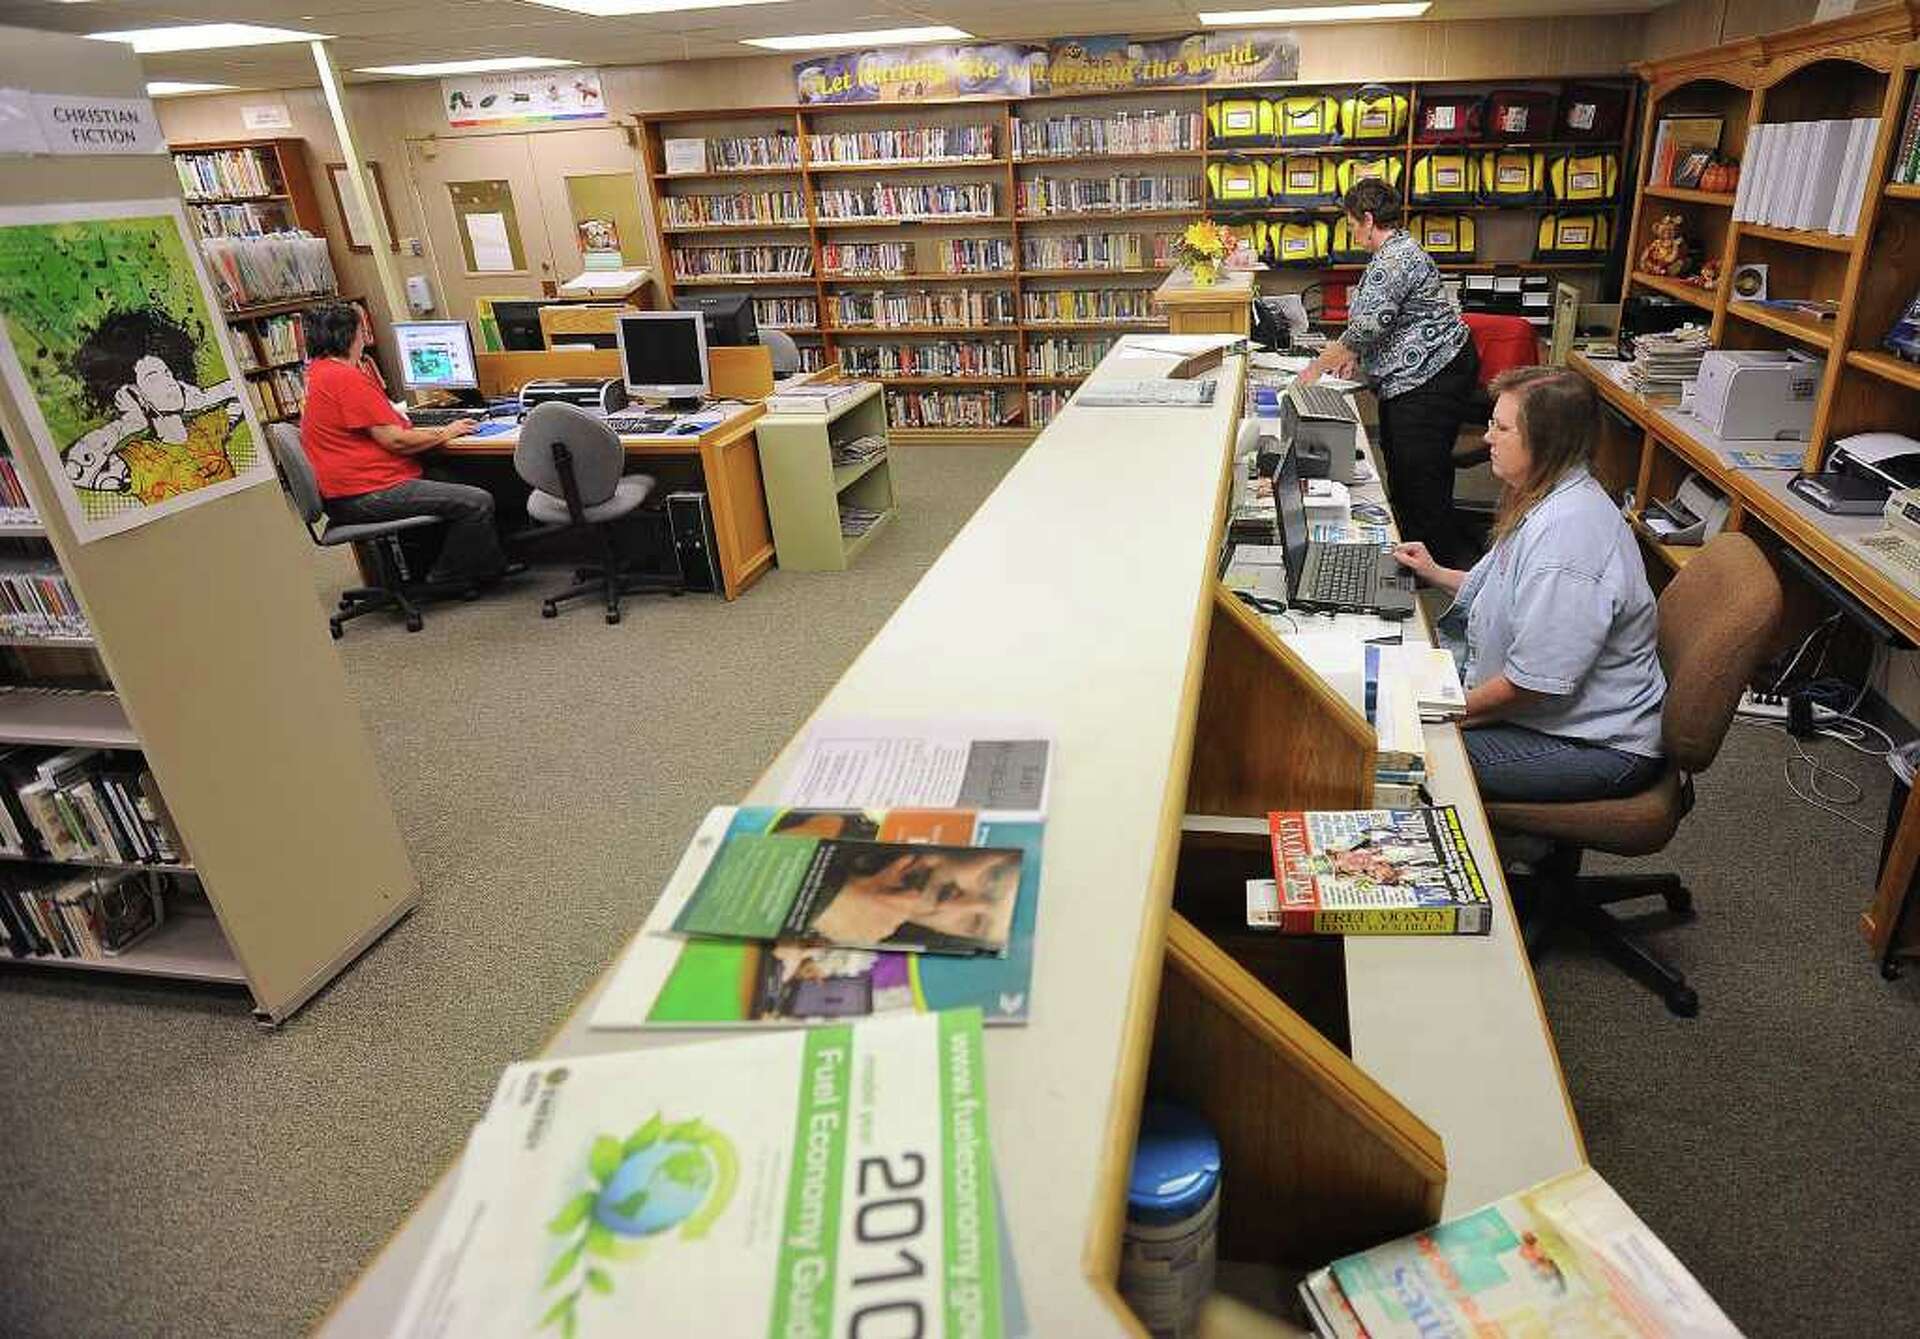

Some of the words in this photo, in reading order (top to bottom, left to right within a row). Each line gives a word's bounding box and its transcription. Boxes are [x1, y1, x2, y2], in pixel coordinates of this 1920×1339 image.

[817, 69, 851, 95] Let
[53, 106, 140, 125] CHRISTIAN
[71, 127, 137, 145] FICTION
[811, 1046, 844, 1107] Fuel
[784, 1111, 840, 1250] Economy
[848, 1151, 927, 1339] 2010
